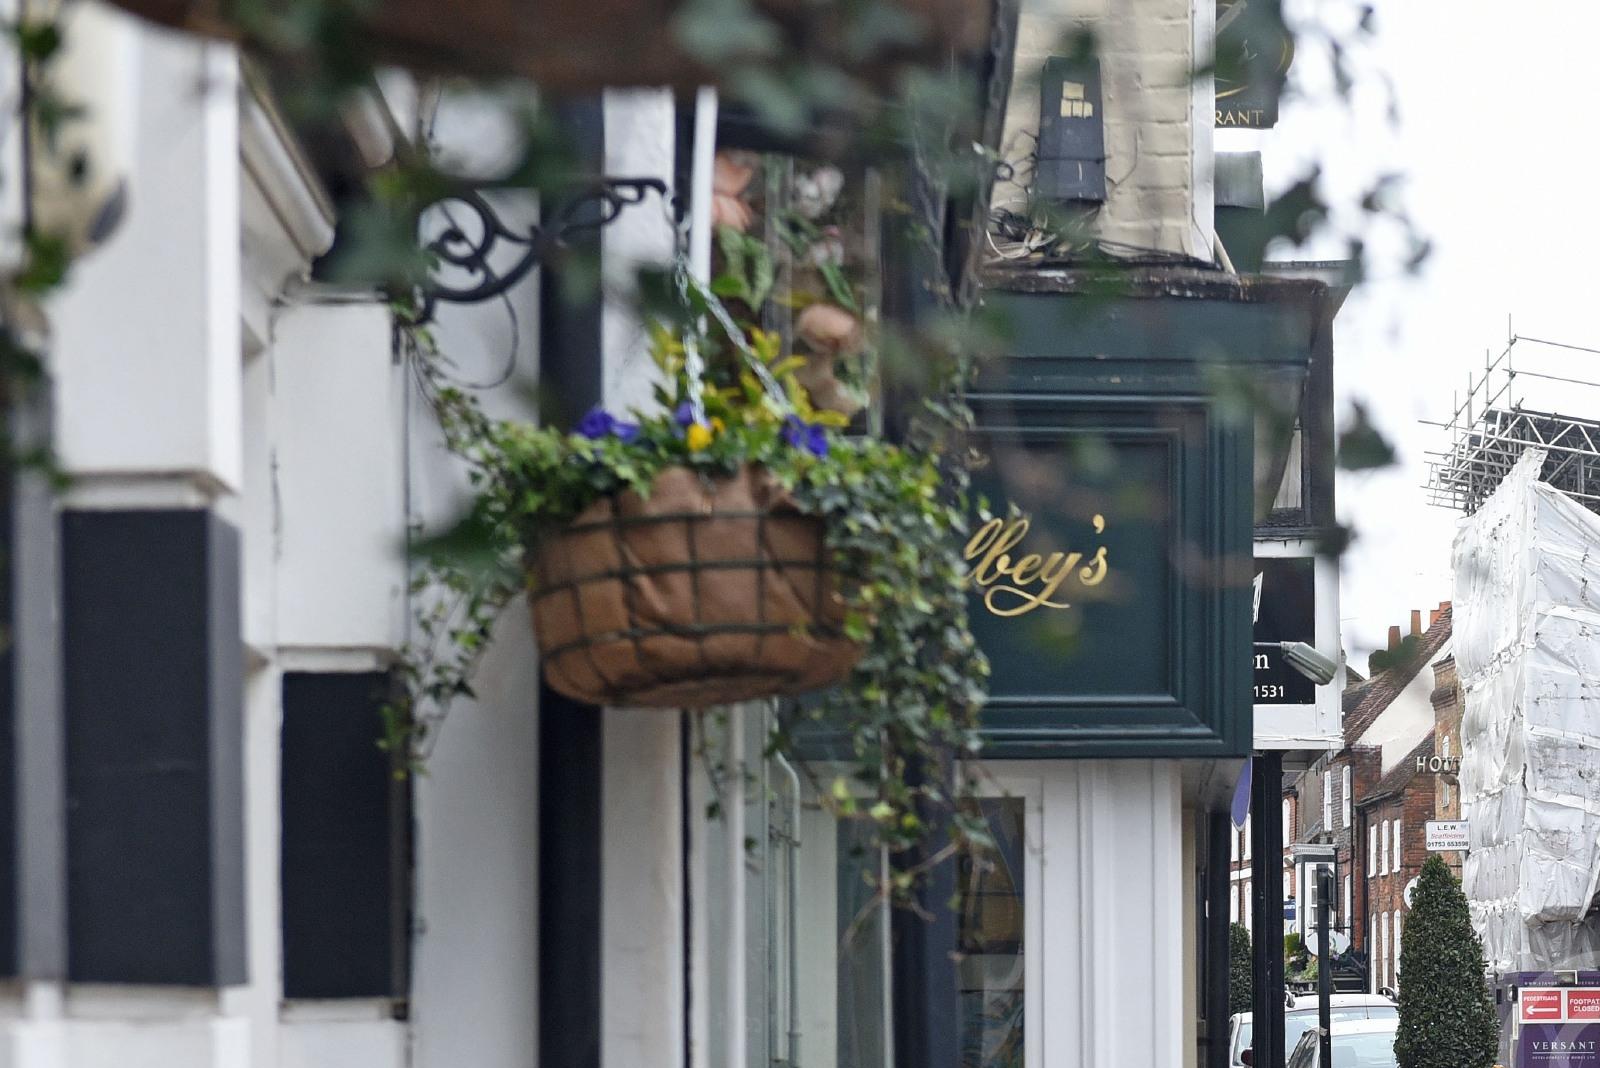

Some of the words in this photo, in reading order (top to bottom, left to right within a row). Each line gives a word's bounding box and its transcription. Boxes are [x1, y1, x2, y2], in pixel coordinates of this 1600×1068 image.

[963, 513, 1108, 617] lbey's
[1253, 653, 1270, 670] n
[1532, 1041, 1596, 1050] VERSANT
